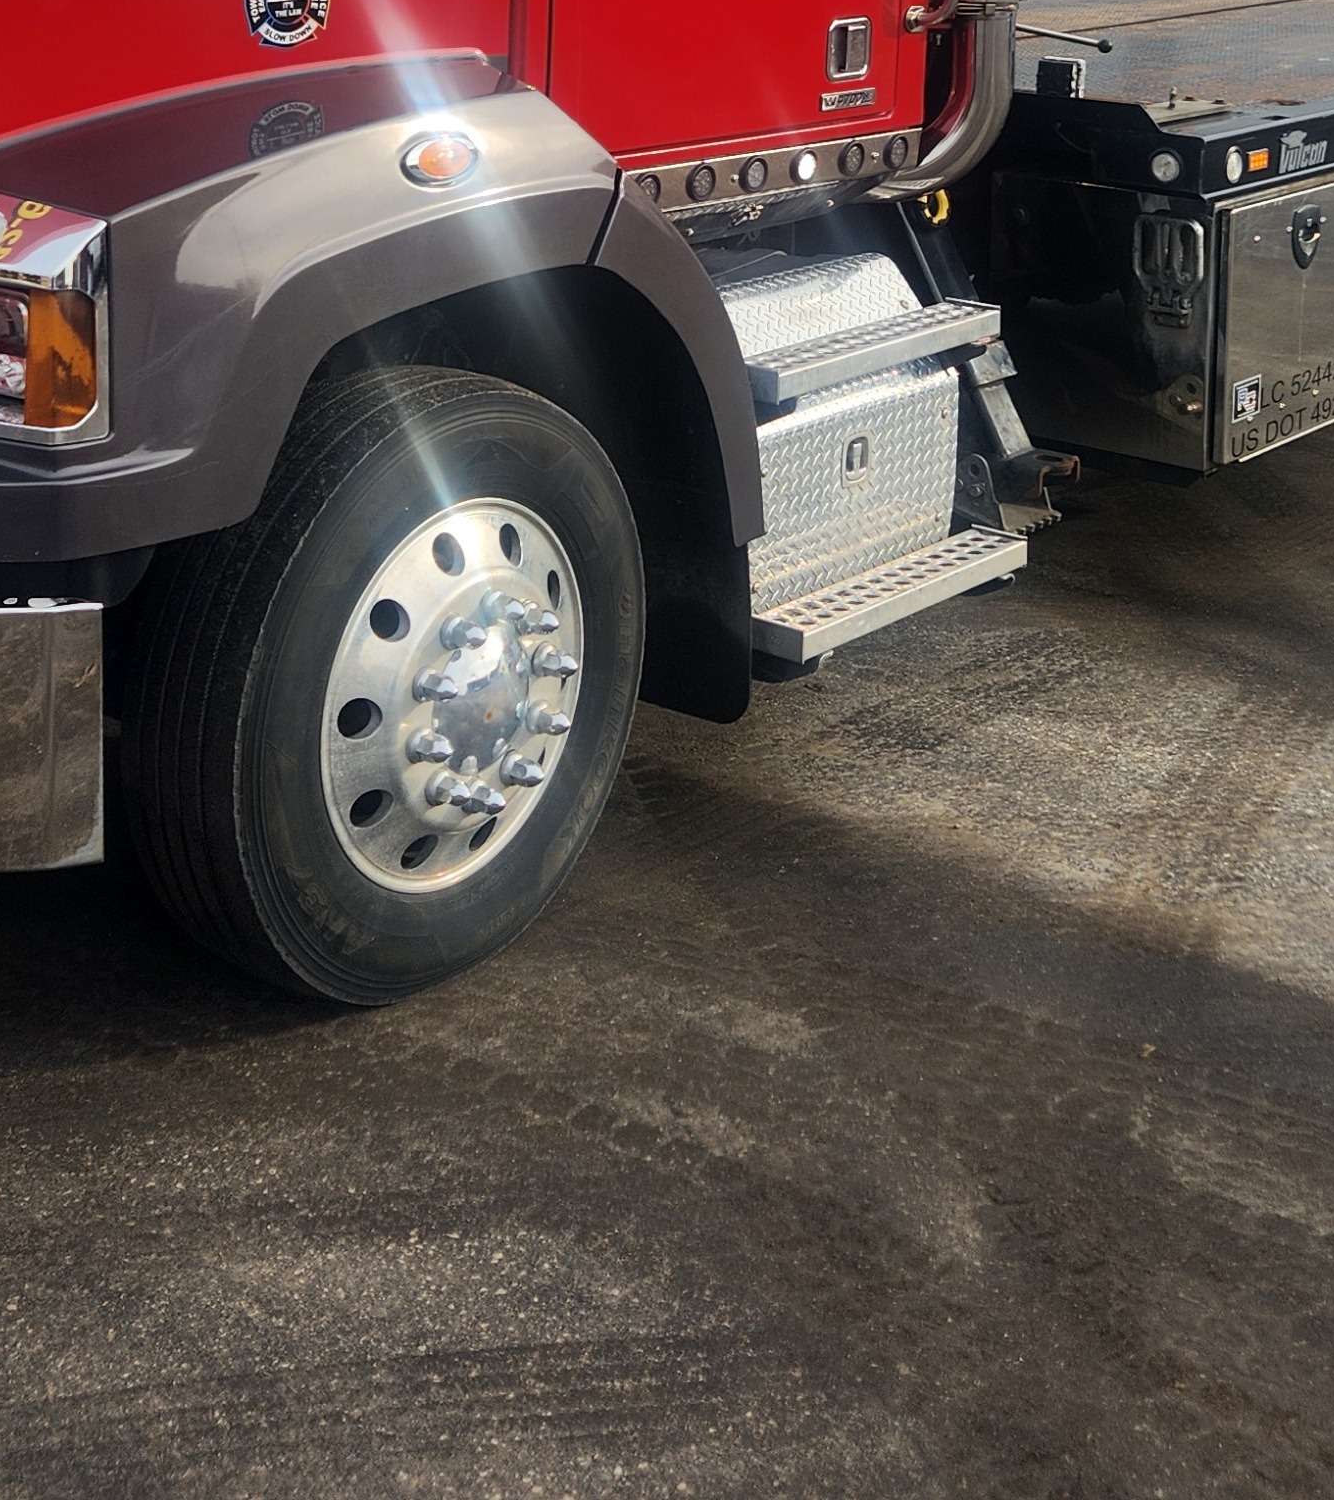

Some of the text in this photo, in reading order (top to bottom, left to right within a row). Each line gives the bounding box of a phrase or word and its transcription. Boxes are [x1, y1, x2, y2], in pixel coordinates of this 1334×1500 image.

[265, 25, 312, 41] SLOW DOWN
[1279, 140, 1327, 174] Vulcan
[1261, 380, 1284, 409] LC
[1232, 428, 1258, 457] US
[1266, 407, 1307, 444] DOT
